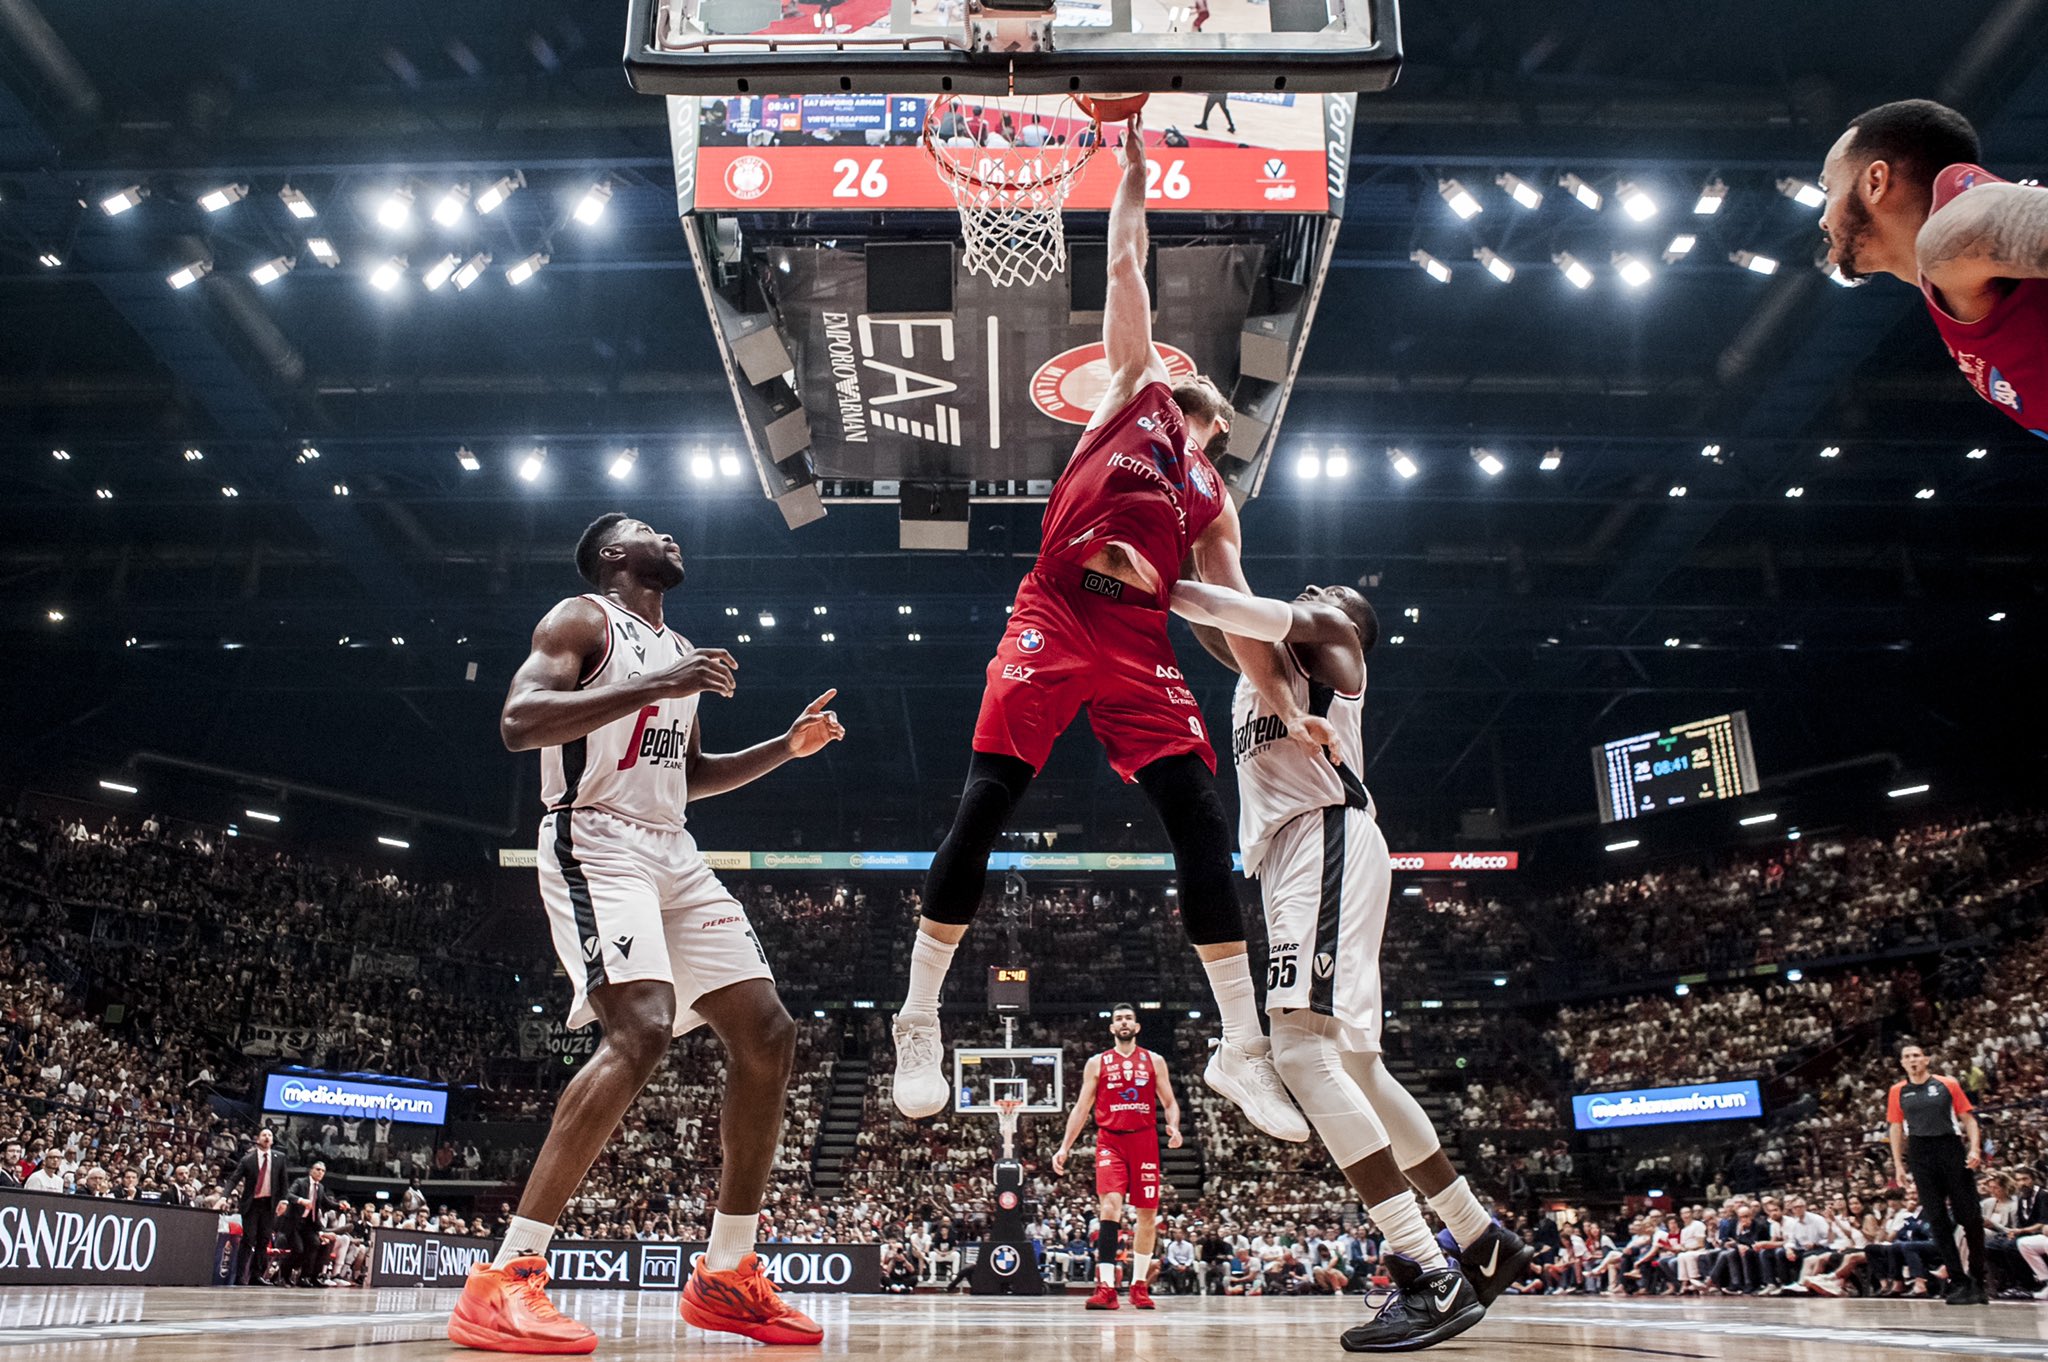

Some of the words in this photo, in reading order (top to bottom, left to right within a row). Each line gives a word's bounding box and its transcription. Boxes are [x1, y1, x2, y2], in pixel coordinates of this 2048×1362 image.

[899, 101, 916, 112] 26
[899, 117, 916, 128] 26
[677, 97, 695, 199] orum
[832, 158, 888, 198] 26
[1145, 159, 1191, 199] 26
[822, 311, 858, 378] EMPORIO
[857, 314, 961, 446] EA7
[1036, 366, 1067, 412] MILANO
[838, 393, 868, 443] ARMANI
[615, 621, 641, 642] 14
[1003, 664, 1036, 680] EA7
[1449, 853, 1508, 869] Adecco
[998, 970, 1026, 981] 8:40
[1267, 954, 1298, 991] 55
[1143, 1185, 1156, 1199] 17
[0, 1207, 157, 1272] SANPAOLO
[380, 1241, 423, 1276] INTESA
